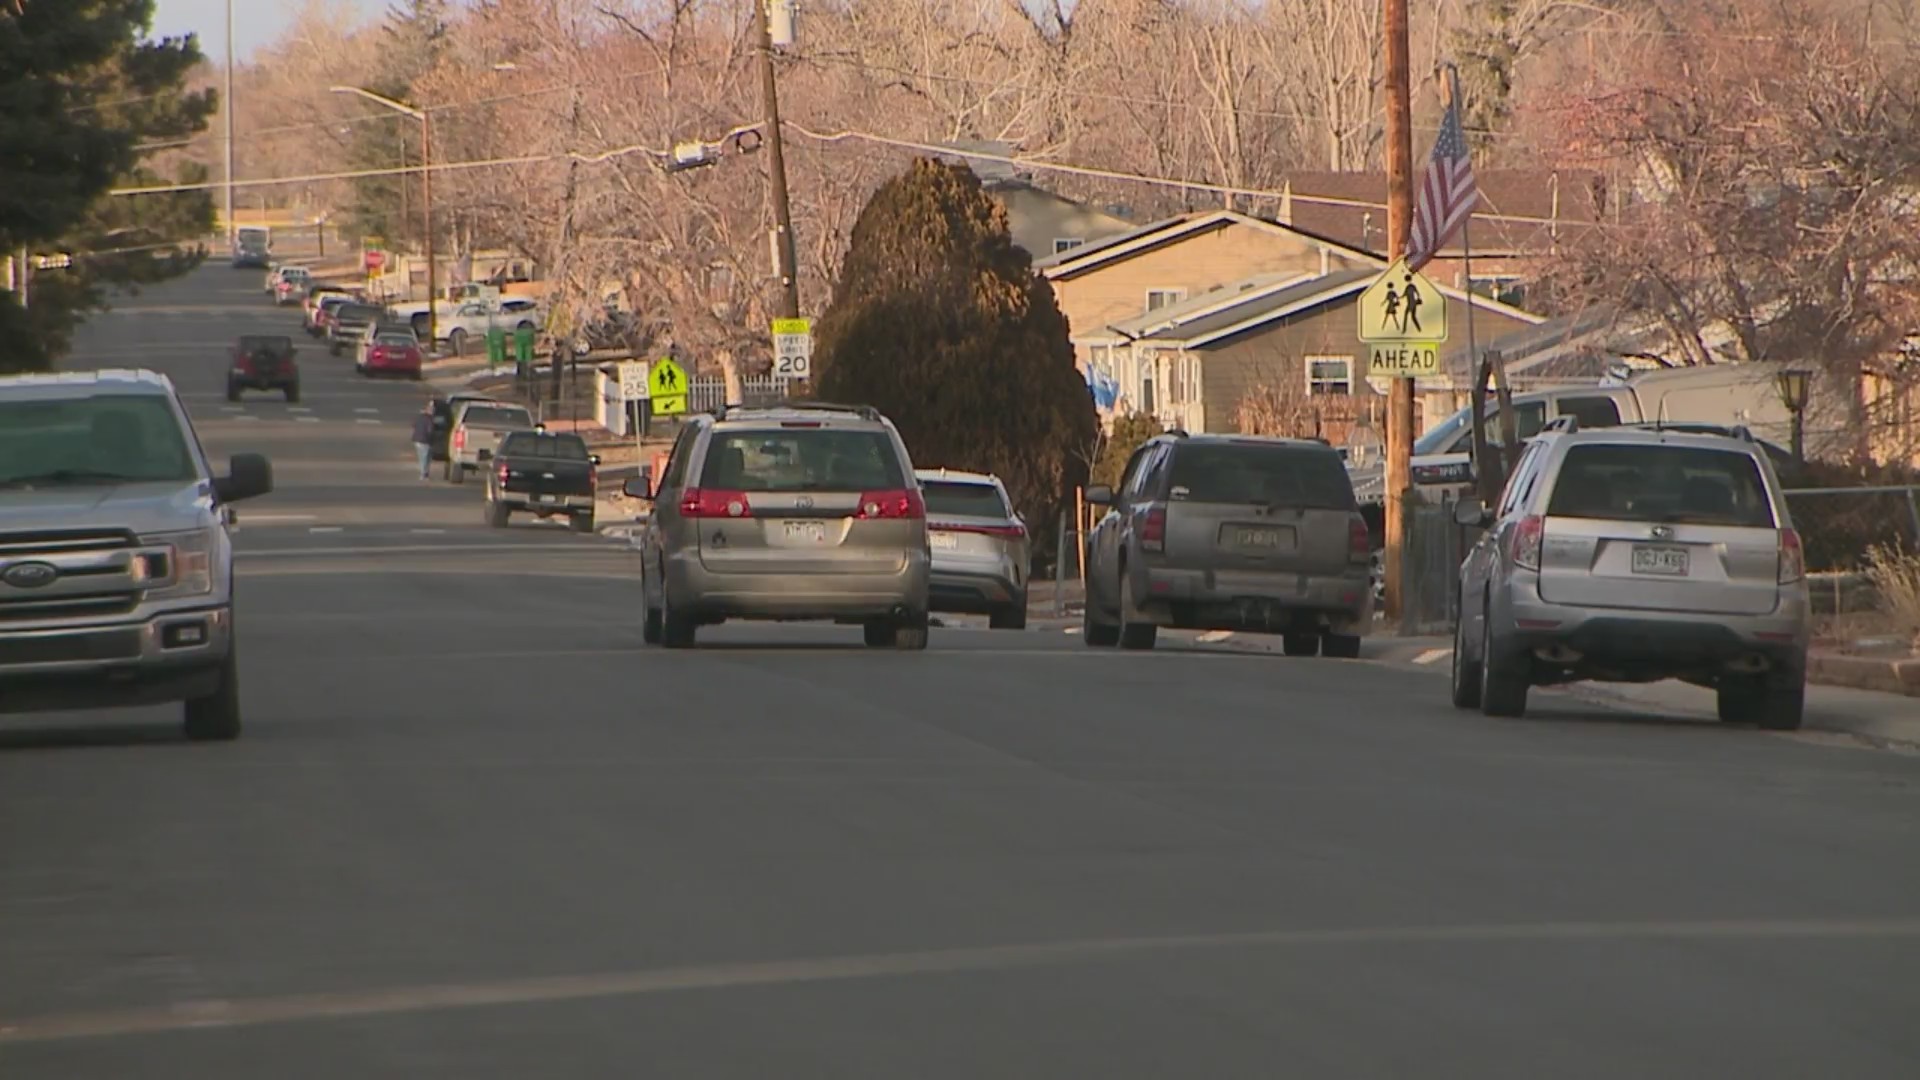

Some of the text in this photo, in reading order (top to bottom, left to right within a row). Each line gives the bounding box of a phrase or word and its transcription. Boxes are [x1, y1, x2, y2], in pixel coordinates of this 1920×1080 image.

[777, 335, 806, 345] SPEED
[779, 356, 806, 372] 20
[1372, 350, 1435, 368] AHEAD
[624, 381, 647, 396] 25
